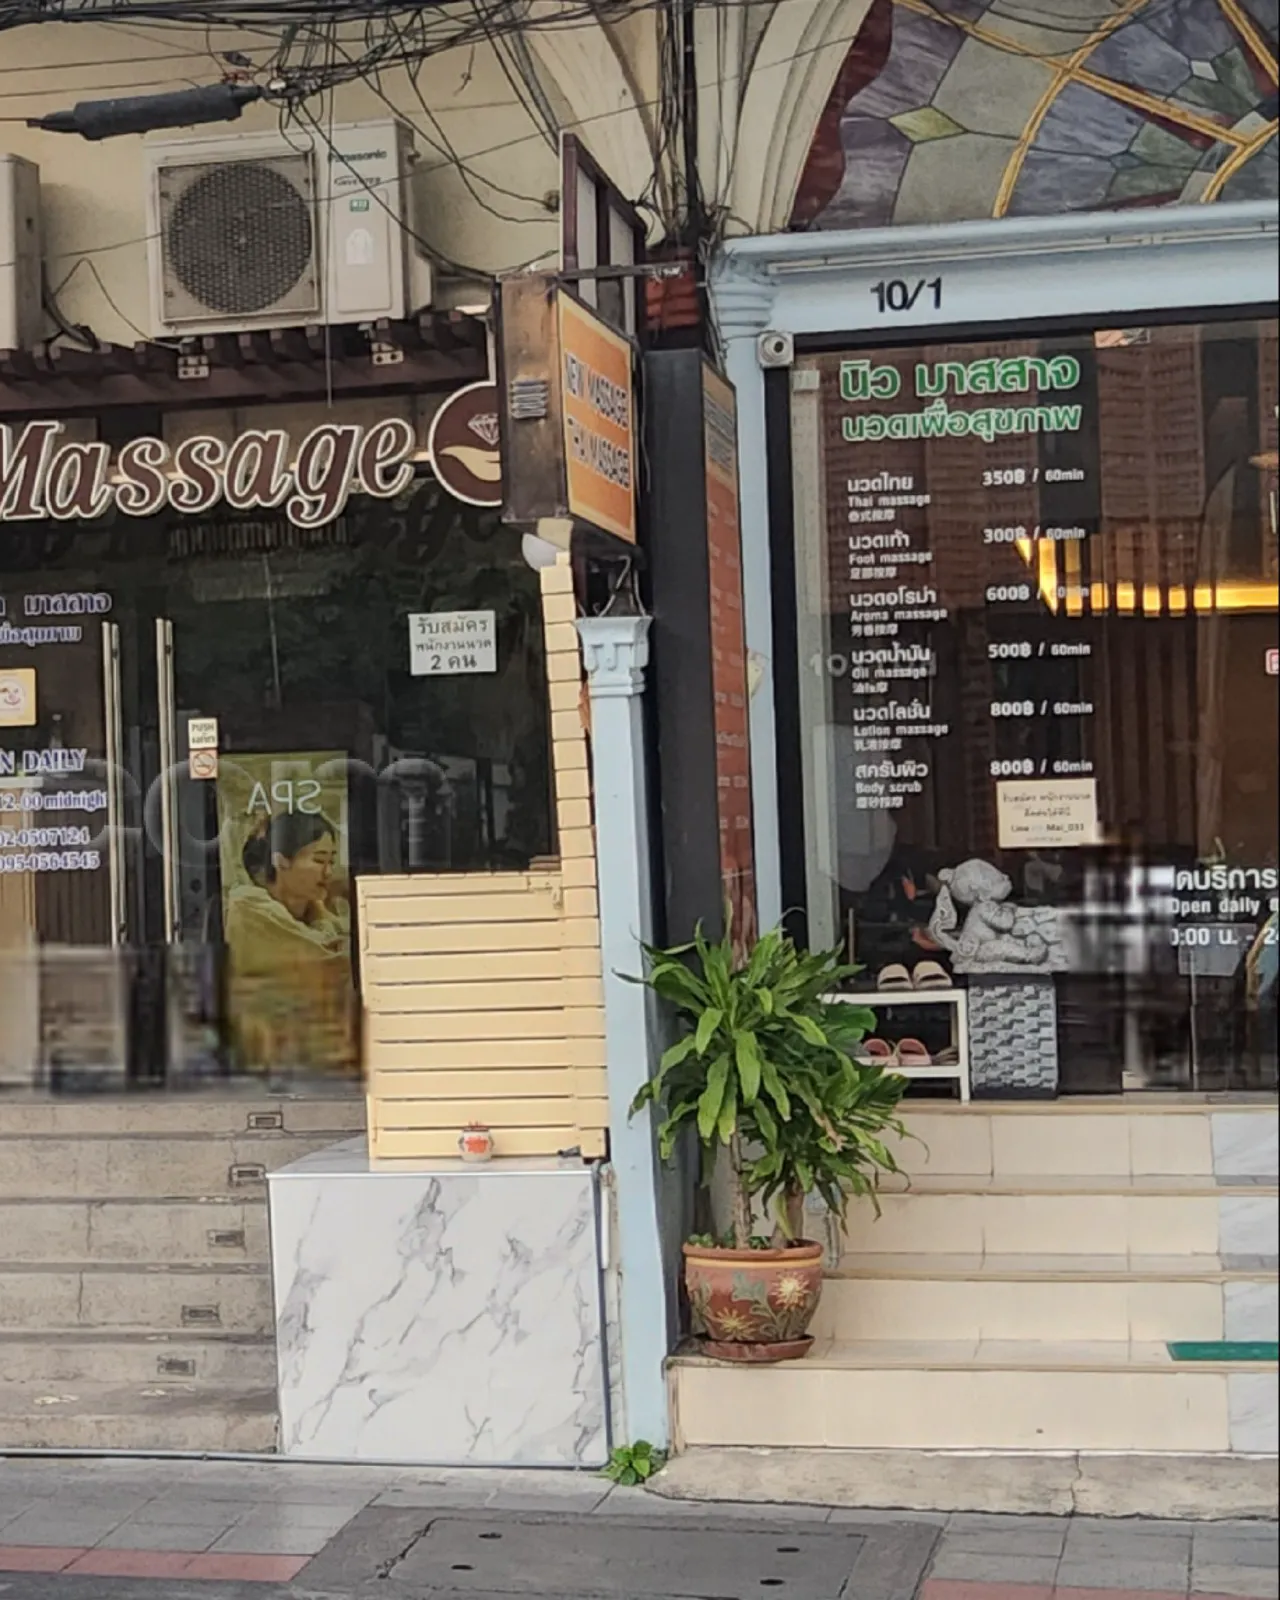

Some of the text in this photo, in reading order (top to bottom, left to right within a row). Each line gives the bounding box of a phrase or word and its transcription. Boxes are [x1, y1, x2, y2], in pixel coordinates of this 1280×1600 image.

[870, 276, 944, 312] 10/1
[840, 355, 1080, 401] นิว มาสสาจ
[564, 351, 629, 432] NEW MASSAGE
[842, 398, 1082, 443] นวดเพื่อสุขภาพ
[847, 471, 913, 493] นวดไทย
[1045, 468, 1085, 482] 60min
[848, 494, 931, 507] Thai massage
[848, 529, 910, 550] นวดเท้า
[1046, 527, 1086, 540] 60min
[848, 551, 933, 565] Foot massage
[850, 585, 937, 607] นวดอโรม่า
[850, 608, 948, 622] Aroma massage
[851, 641, 931, 664] นวดน้ำมัน
[1050, 642, 1091, 656] 60min
[431, 655, 478, 671] 2 คน
[851, 666, 928, 680] Oil massage
[853, 697, 931, 721] นวดโลชั่น
[1053, 701, 1094, 715] 60min
[853, 724, 949, 737] Lotion massage
[22, 749, 88, 772] DAILY
[1052, 759, 1094, 774] 60min
[855, 760, 929, 779] สครับผิว
[855, 780, 923, 795] Body scrub
[1219, 897, 1260, 916] daily
